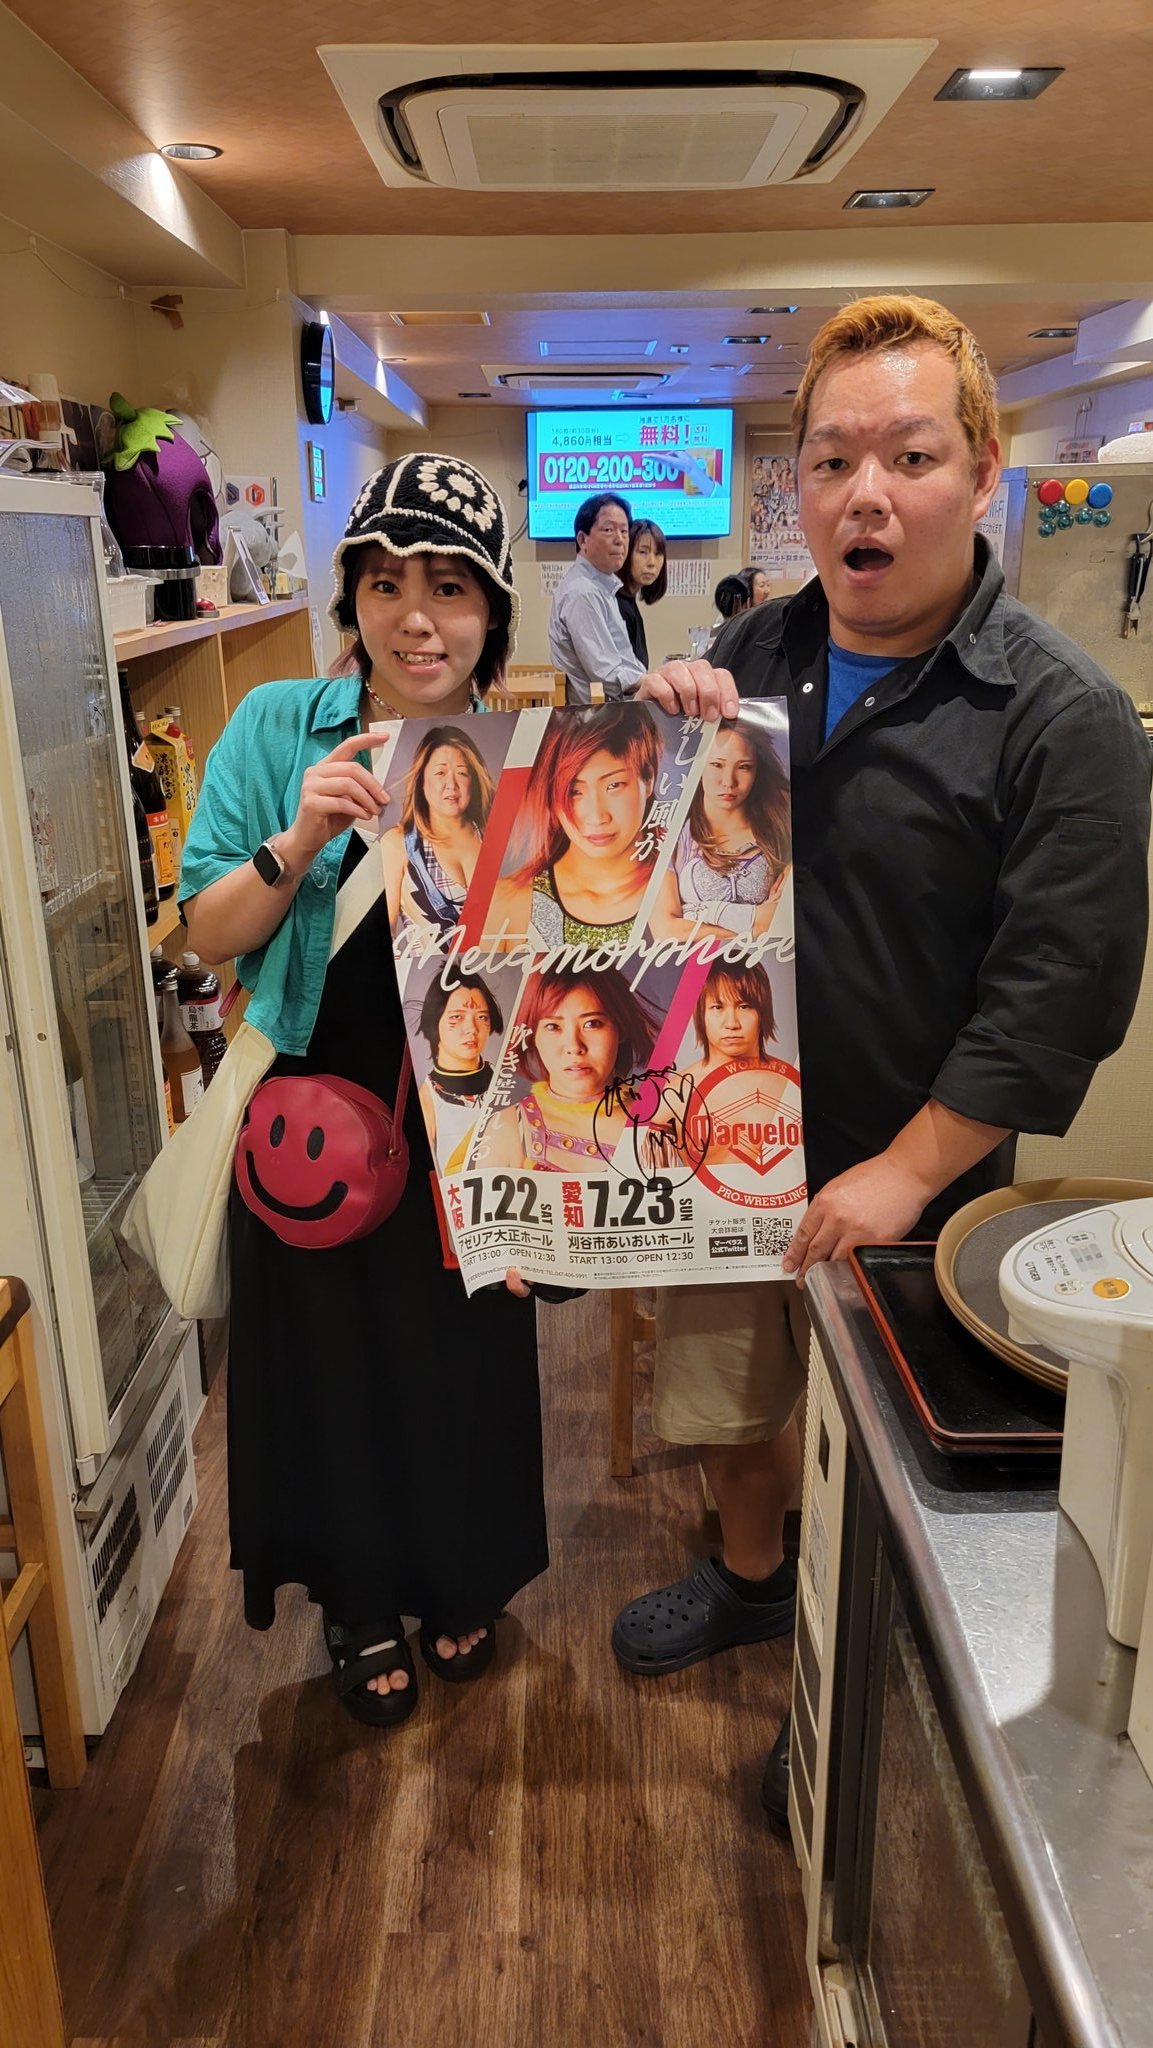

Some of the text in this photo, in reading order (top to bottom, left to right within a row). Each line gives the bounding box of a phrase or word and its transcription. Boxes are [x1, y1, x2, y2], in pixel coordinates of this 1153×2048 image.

[552, 435, 612, 447] 4,860円相当
[392, 918, 796, 992] Metamorphose
[725, 1060, 788, 1074] WOMEN'S
[690, 1115, 804, 1147] Marvelo
[447, 1184, 465, 1230] 大阪
[463, 1175, 540, 1226] 7.22
[561, 1181, 585, 1228] 愛知
[587, 1176, 675, 1228] 7.23
[716, 1184, 808, 1207] PRO-WRESTLING
[540, 1203, 553, 1225] SAT
[679, 1198, 693, 1222] SUN
[459, 1229, 553, 1254] アゼリア大正ホール
[568, 1233, 695, 1250] 刈谷市あいおいホール
[533, 1251, 556, 1262] 12:30
[569, 1255, 597, 1265] START
[666, 1251, 694, 1262] 12:30
